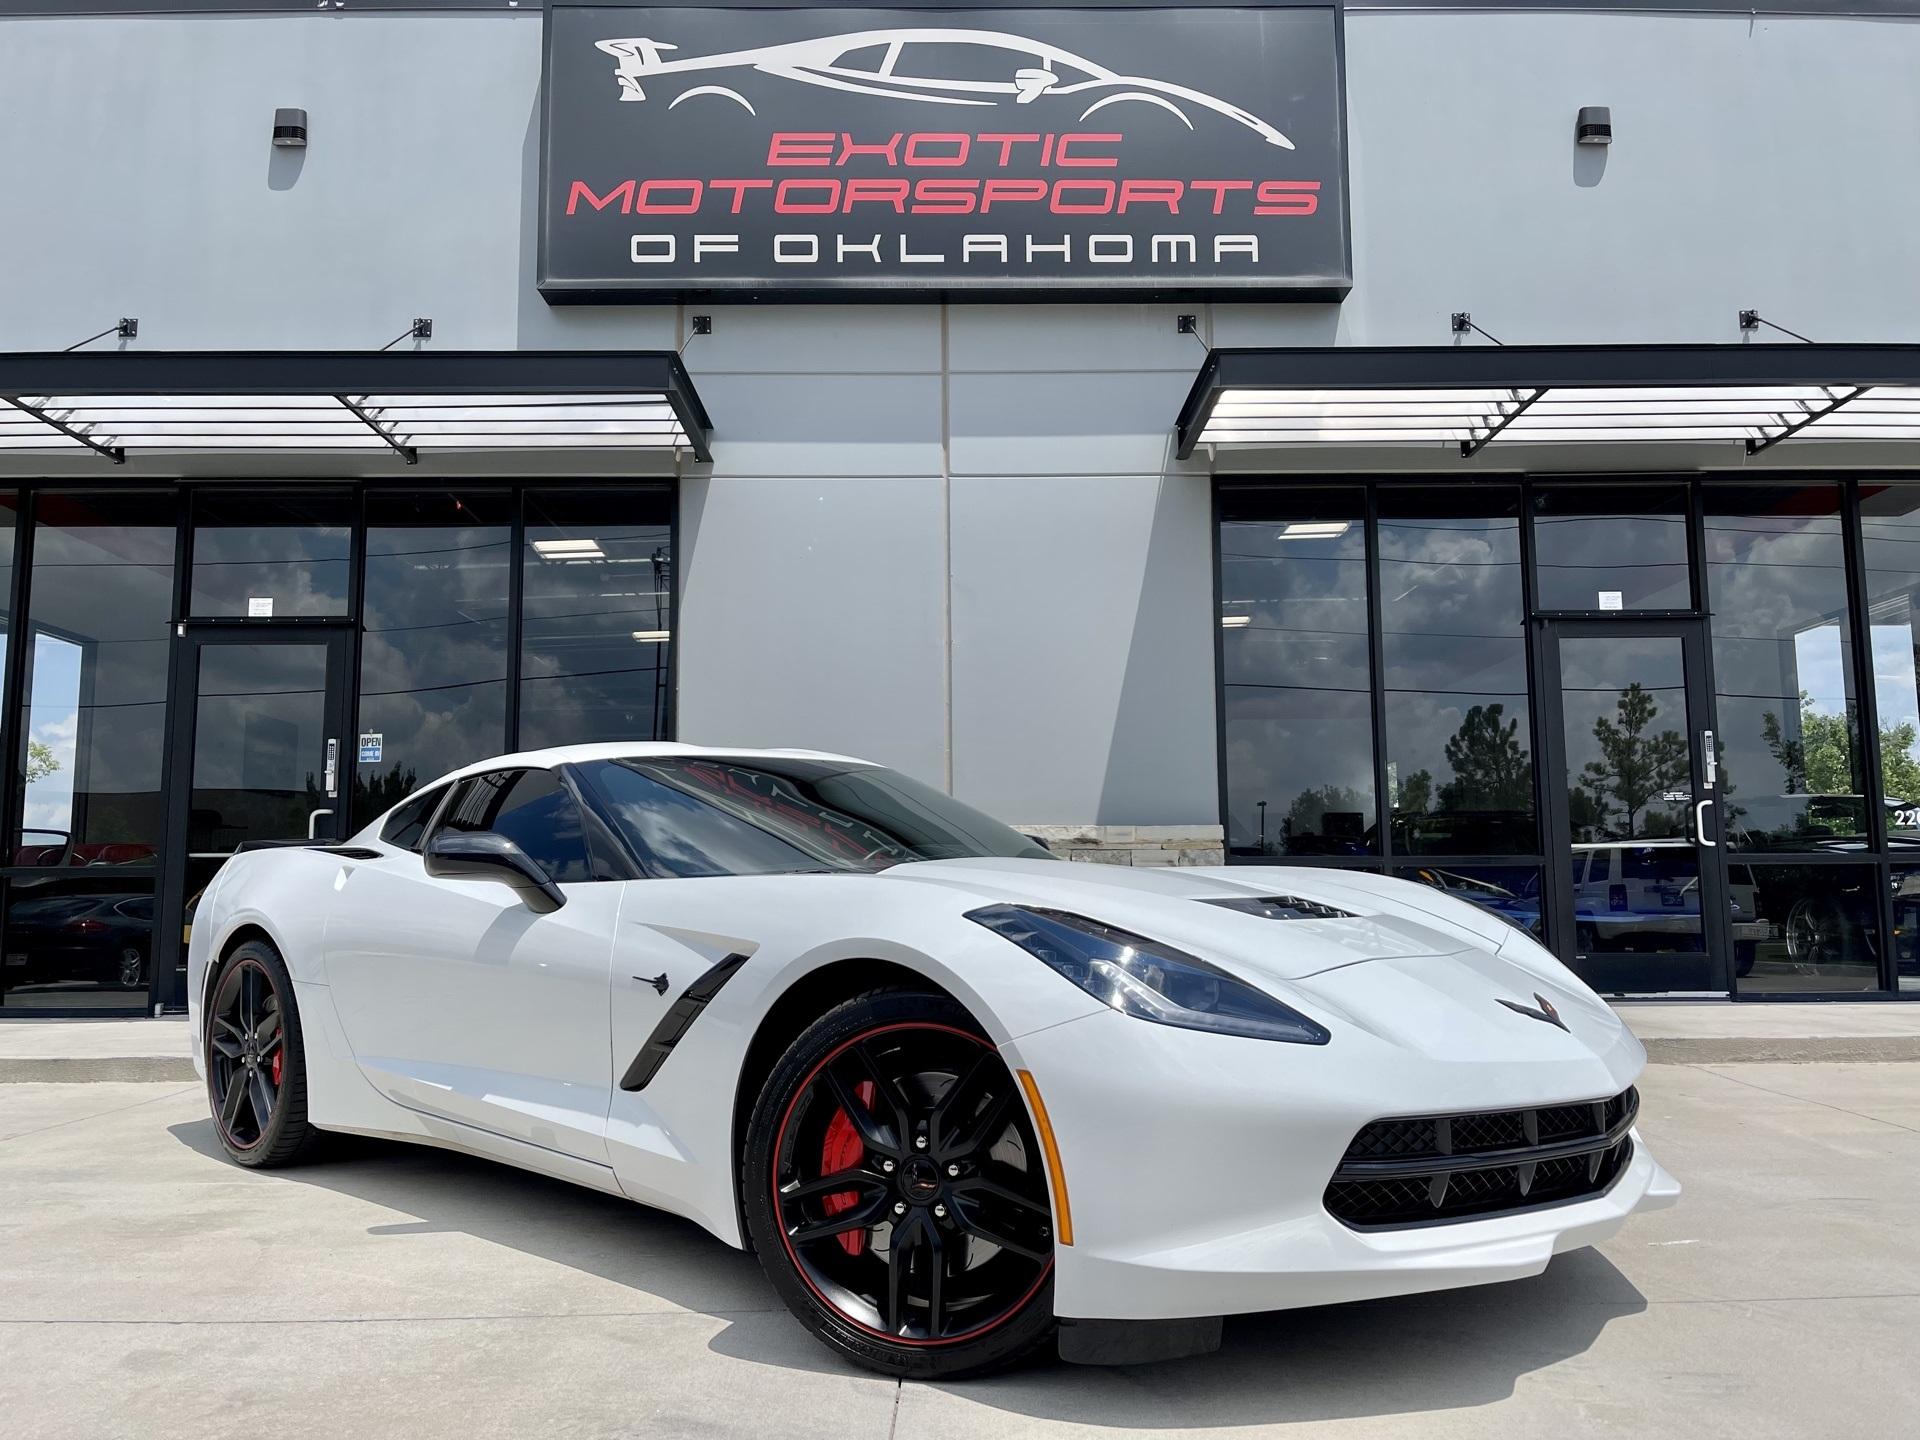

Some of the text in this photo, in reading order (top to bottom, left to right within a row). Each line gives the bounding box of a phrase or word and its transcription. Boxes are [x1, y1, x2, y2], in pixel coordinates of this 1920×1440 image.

[766, 131, 1122, 168] EXOTIC
[565, 178, 1321, 216] MOTORSPORTS
[630, 234, 1260, 263] OF OKLAHOMA
[361, 737, 382, 747] OPEN
